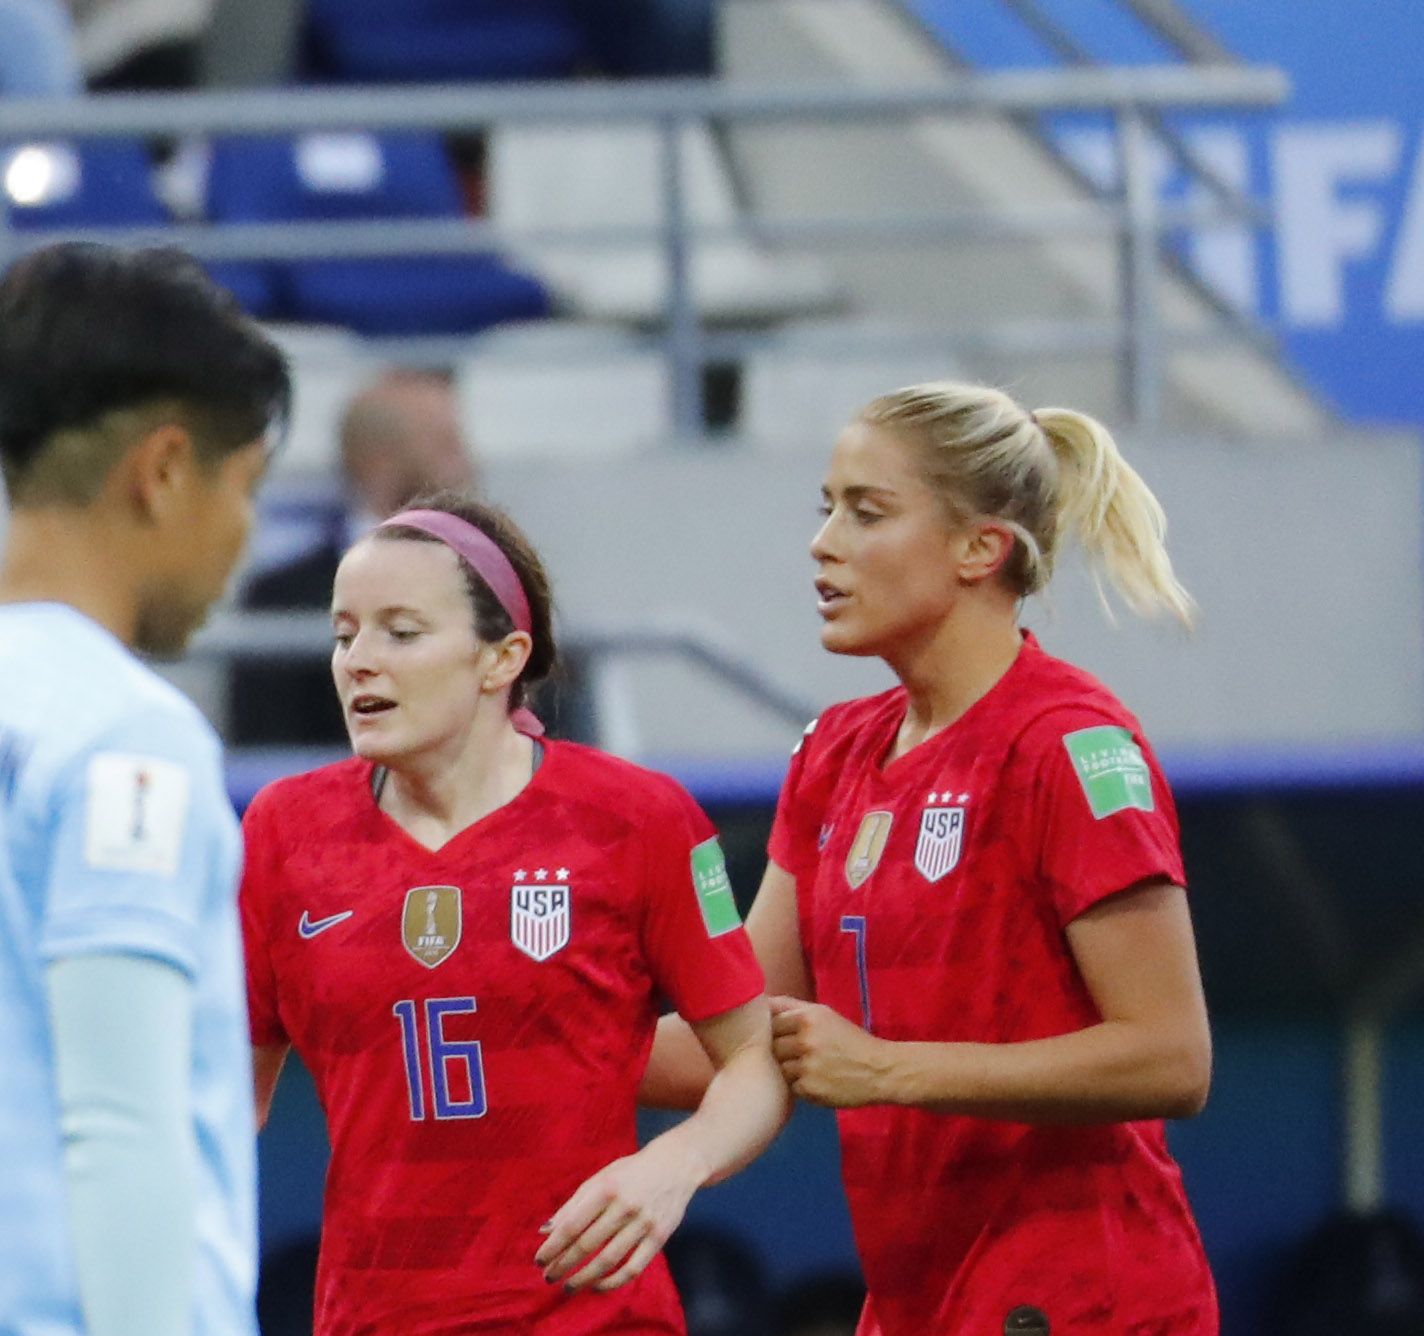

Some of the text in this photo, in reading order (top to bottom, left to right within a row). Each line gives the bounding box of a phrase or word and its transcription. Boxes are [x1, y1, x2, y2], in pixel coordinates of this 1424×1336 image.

[925, 812, 960, 839] USA
[516, 889, 565, 917] USA
[393, 996, 487, 1121] 16
